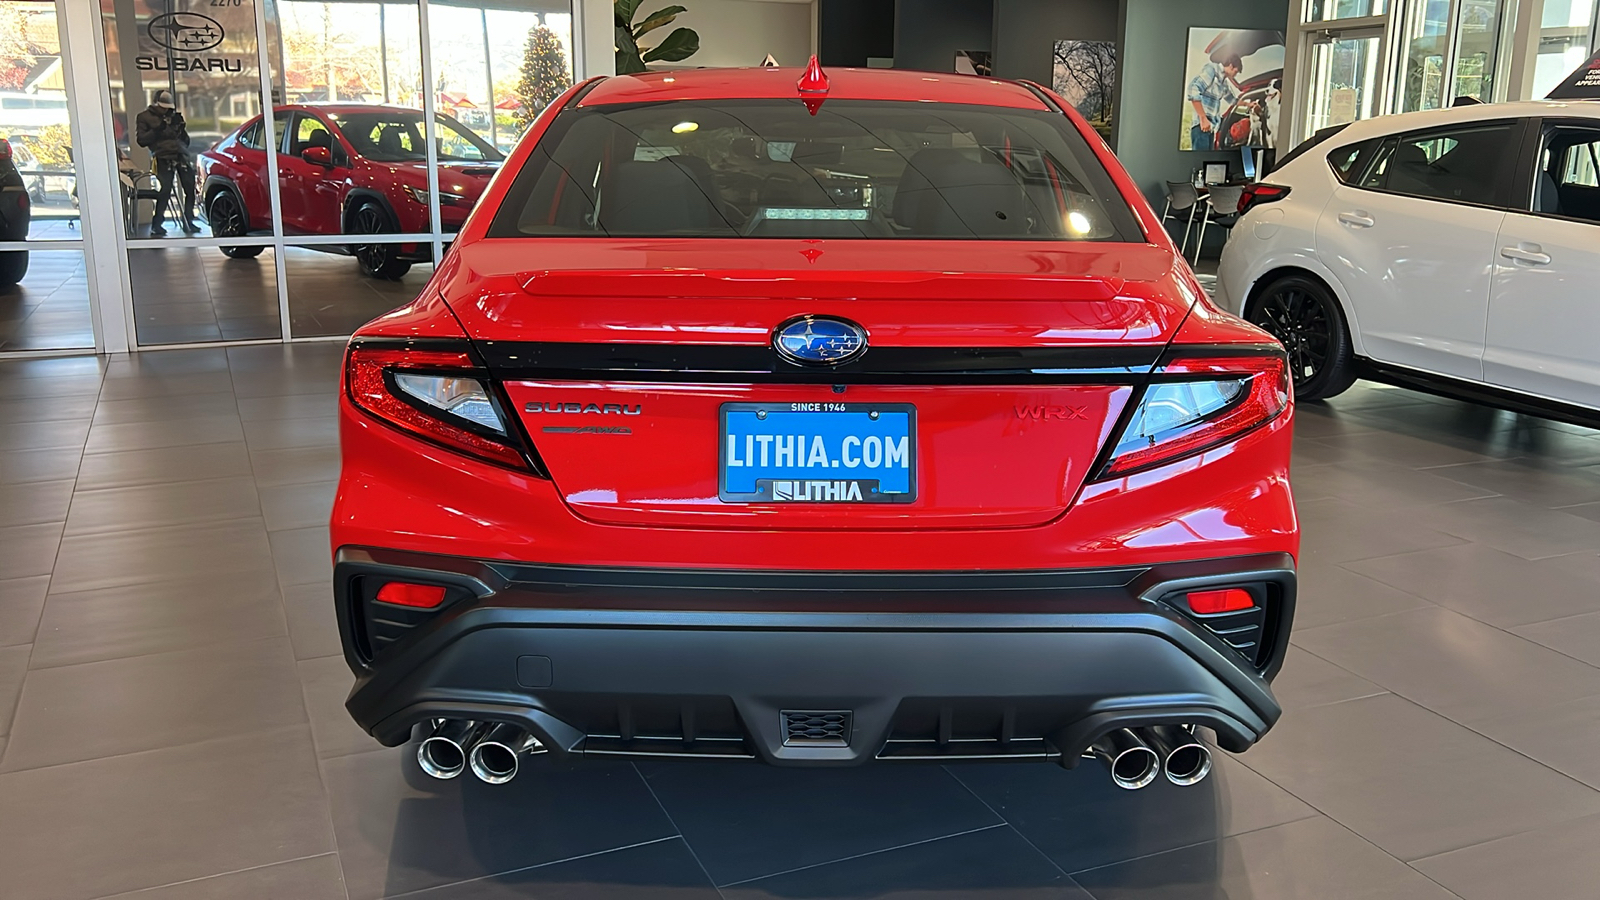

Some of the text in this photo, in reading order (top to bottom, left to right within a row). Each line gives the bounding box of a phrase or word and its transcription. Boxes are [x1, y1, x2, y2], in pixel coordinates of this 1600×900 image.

[135, 57, 241, 72] SUBARU
[525, 402, 641, 415] SUBARU
[791, 403, 846, 412] SINCE 1946
[1013, 405, 1089, 420] WRX
[575, 426, 633, 435] AWD
[728, 434, 909, 468] LITHIA.COM
[793, 481, 863, 501] LITHIA
